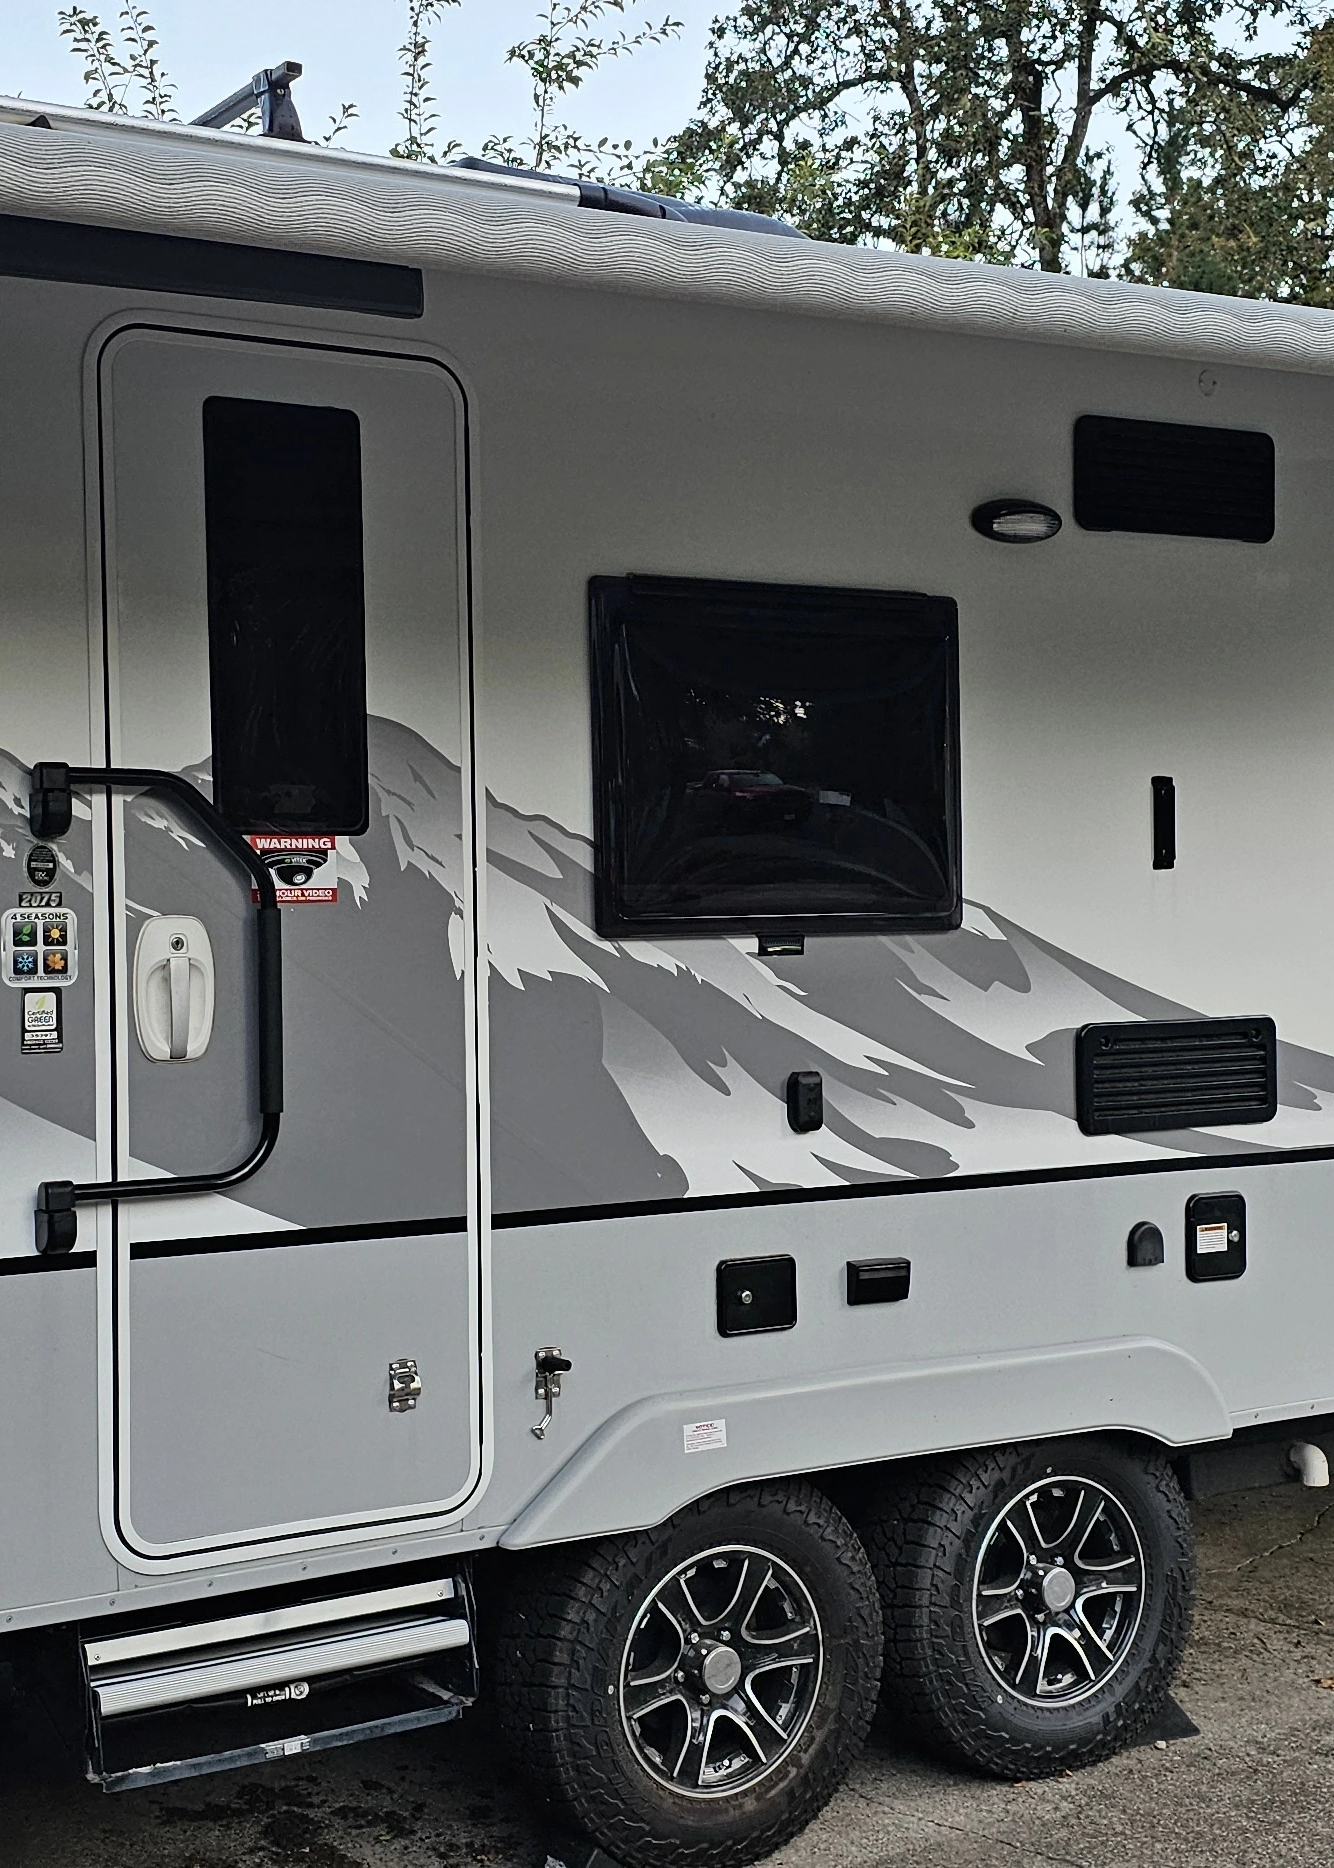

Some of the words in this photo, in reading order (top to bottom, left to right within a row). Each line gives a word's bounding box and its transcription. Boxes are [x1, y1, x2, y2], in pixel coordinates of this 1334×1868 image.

[255, 838, 332, 849] WARNING
[303, 889, 333, 897] VIDEO
[20, 892, 61, 907] 2075
[10, 912, 17, 920] 4
[19, 912, 69, 920] SEASONS
[27, 1015, 54, 1024] GREEN
